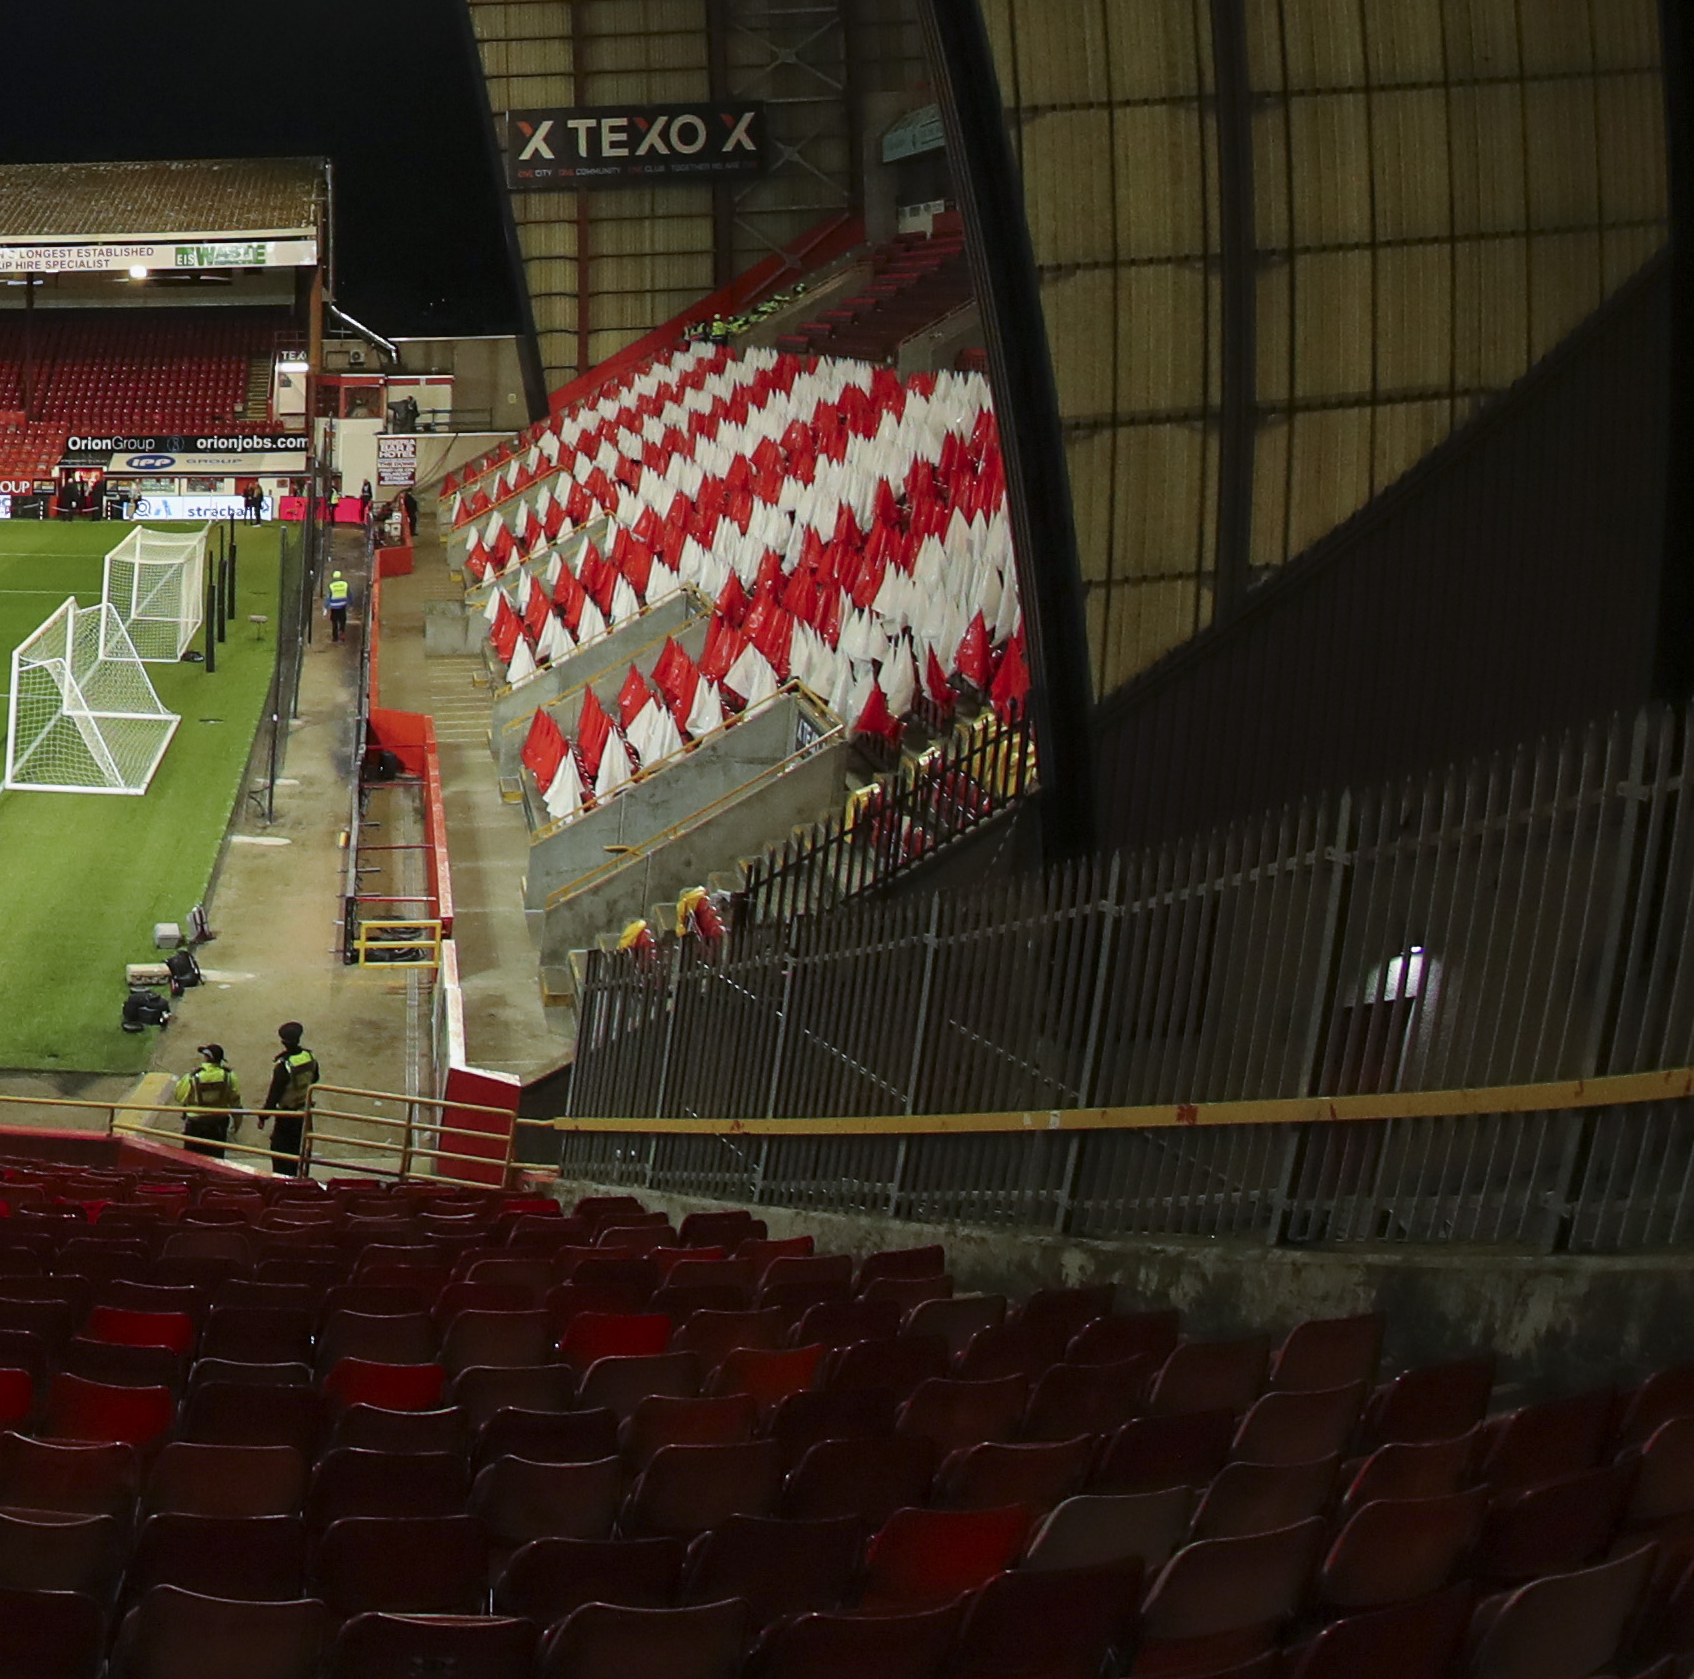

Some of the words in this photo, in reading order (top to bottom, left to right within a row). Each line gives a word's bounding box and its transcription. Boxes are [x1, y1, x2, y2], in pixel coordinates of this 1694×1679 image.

[567, 114, 707, 157] TEXO
[535, 169, 552, 177] CITY
[576, 167, 622, 176] COMMUNITY
[644, 165, 666, 173] CLUB
[20, 248, 72, 259] LONGEST
[77, 247, 154, 258] ESTABLISHED
[177, 254, 194, 266] EIS
[196, 245, 266, 266] WASTE
[16, 260, 41, 270] HIRE
[45, 259, 110, 270] SPECIALIST
[196, 435, 309, 451] orionjobs.com
[132, 458, 172, 467] IPP
